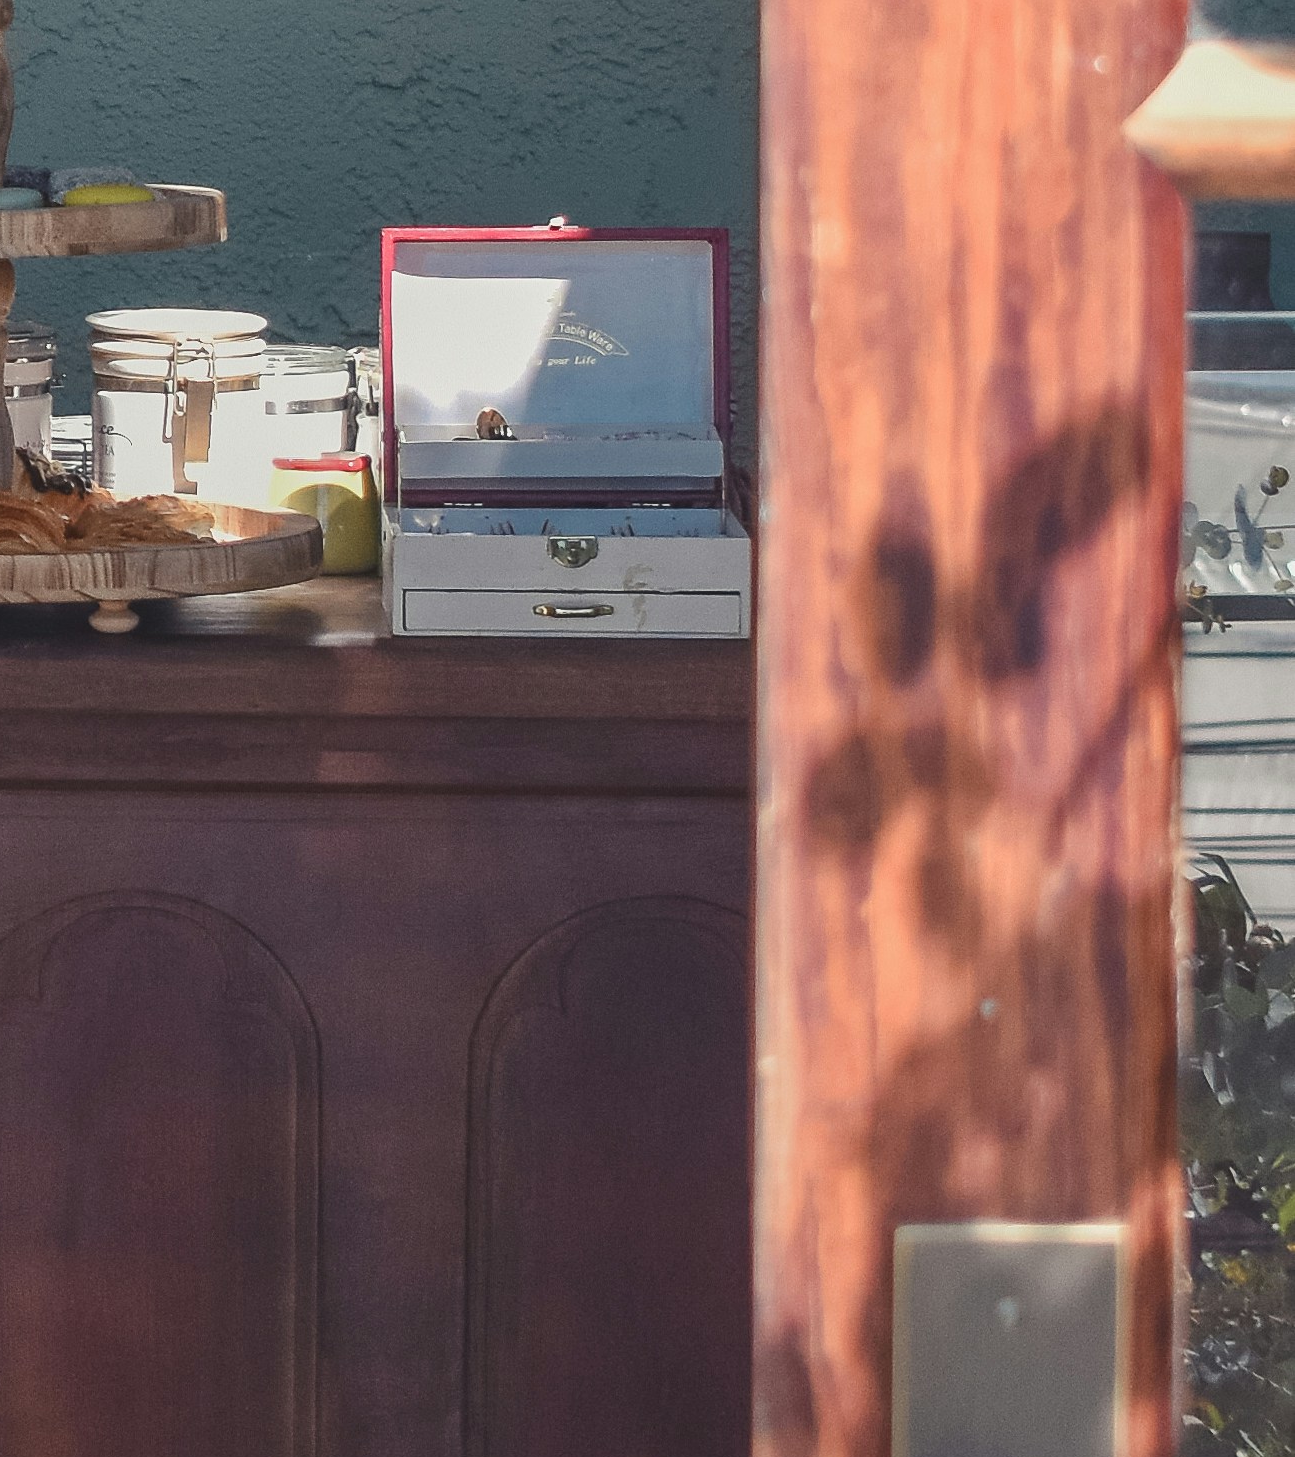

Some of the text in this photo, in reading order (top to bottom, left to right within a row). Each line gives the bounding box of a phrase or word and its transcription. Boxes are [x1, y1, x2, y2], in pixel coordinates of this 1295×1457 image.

[559, 322, 586, 338] Table
[588, 329, 613, 352] Ware
[574, 355, 597, 366] Life
